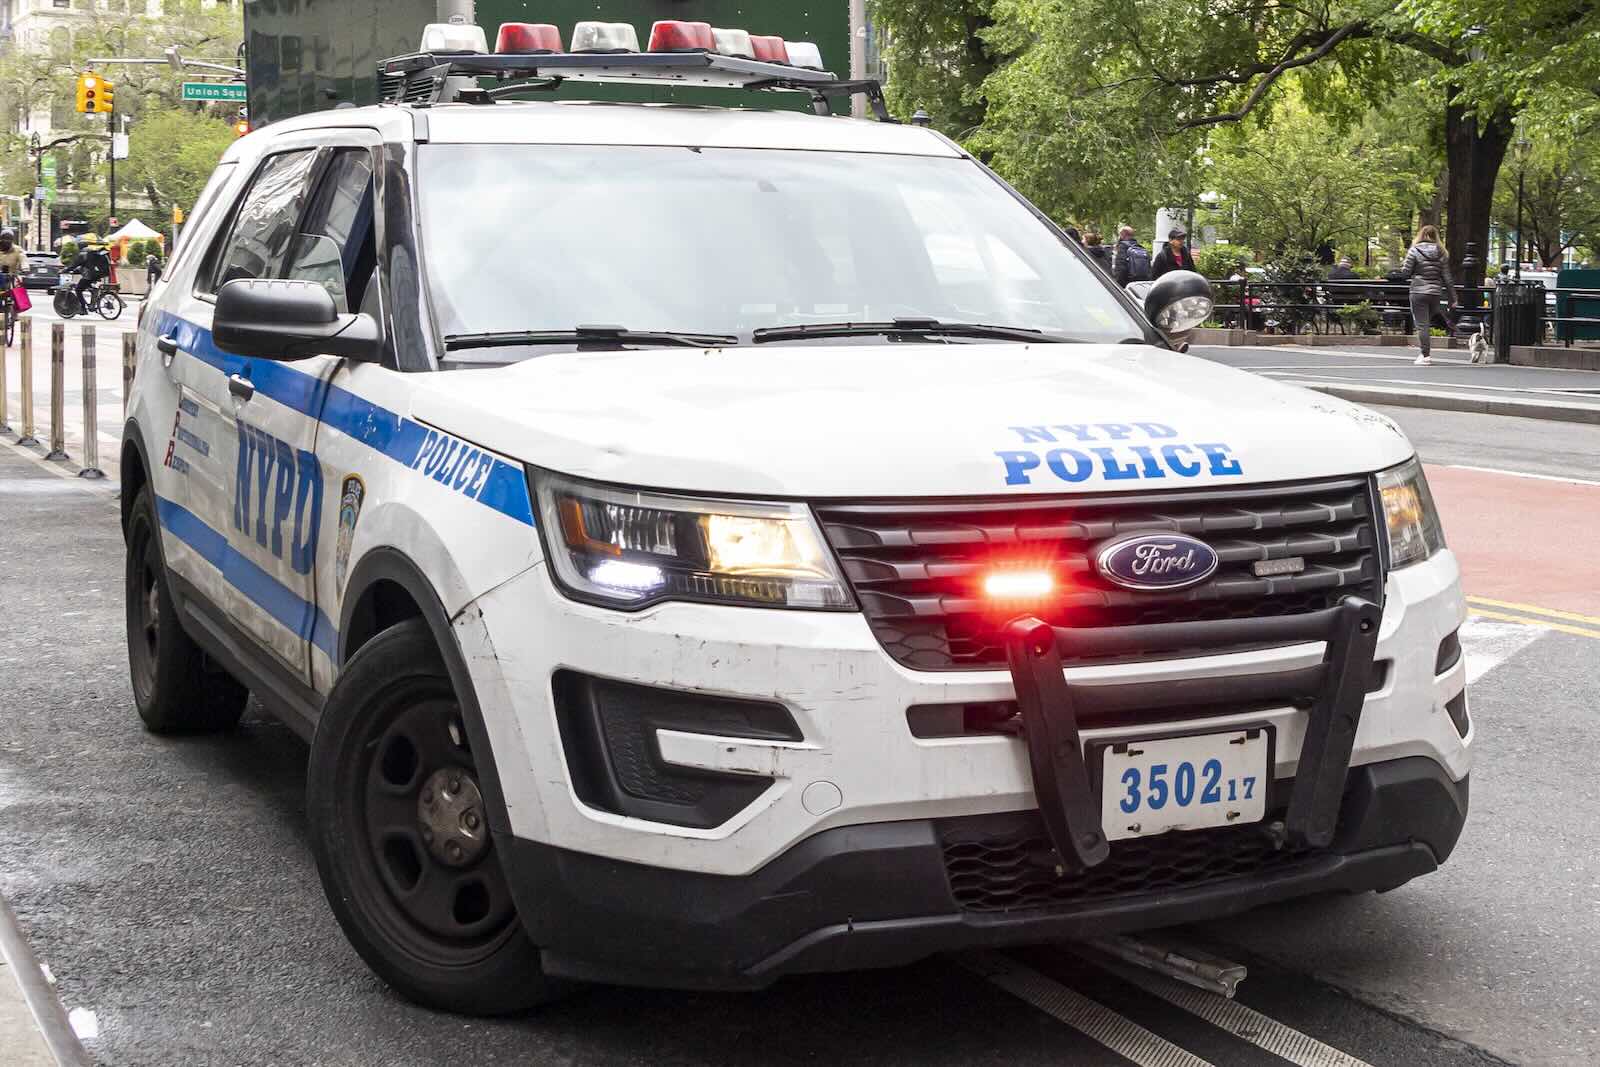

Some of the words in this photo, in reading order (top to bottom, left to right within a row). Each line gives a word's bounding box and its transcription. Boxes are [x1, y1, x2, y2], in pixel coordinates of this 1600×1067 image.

[187, 87, 219, 96] Union
[1007, 421, 1178, 444] NYPD
[411, 429, 494, 500] POLICE
[994, 443, 1243, 485] POLICE
[234, 418, 324, 576] NYPD
[1131, 543, 1198, 575] Ford
[1120, 758, 1222, 814] 3502
[1227, 776, 1256, 801] 17
